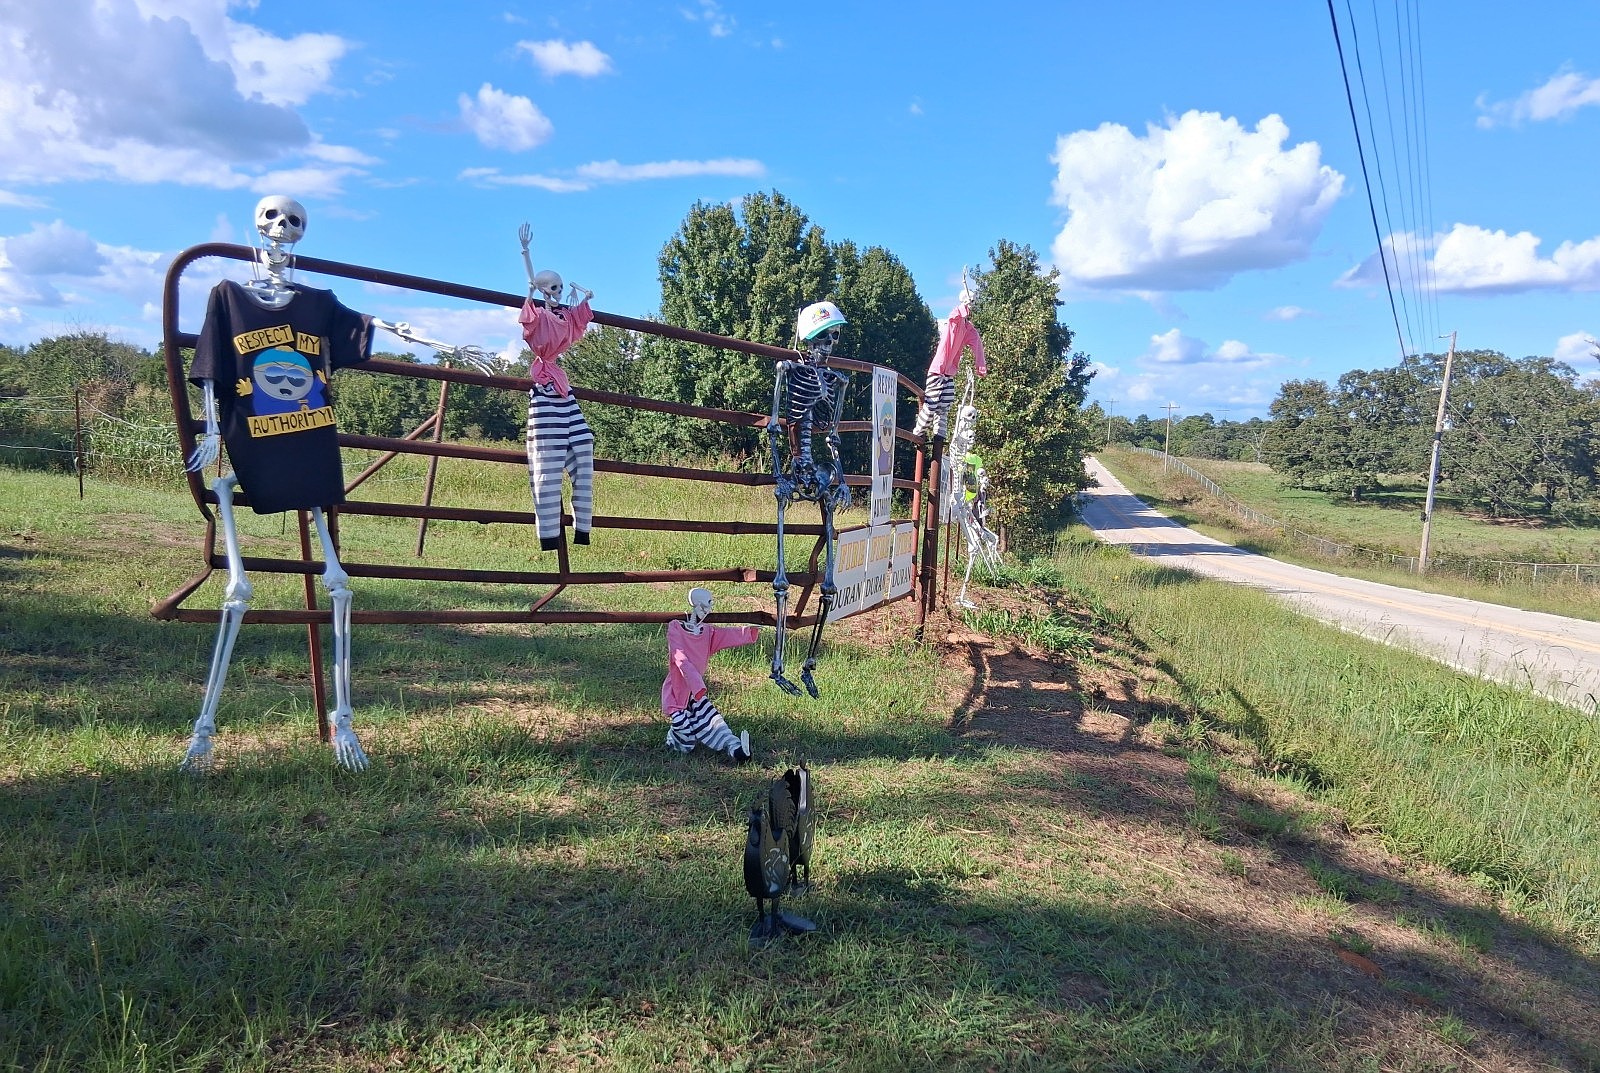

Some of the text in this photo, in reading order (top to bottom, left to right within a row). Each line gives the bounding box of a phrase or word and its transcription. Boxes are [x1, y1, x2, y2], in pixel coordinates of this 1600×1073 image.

[237, 326, 320, 353] RESPECT MY
[252, 407, 334, 435] AUTHORITY!
[838, 539, 866, 573] FIRE
[829, 581, 864, 612] DURAN
